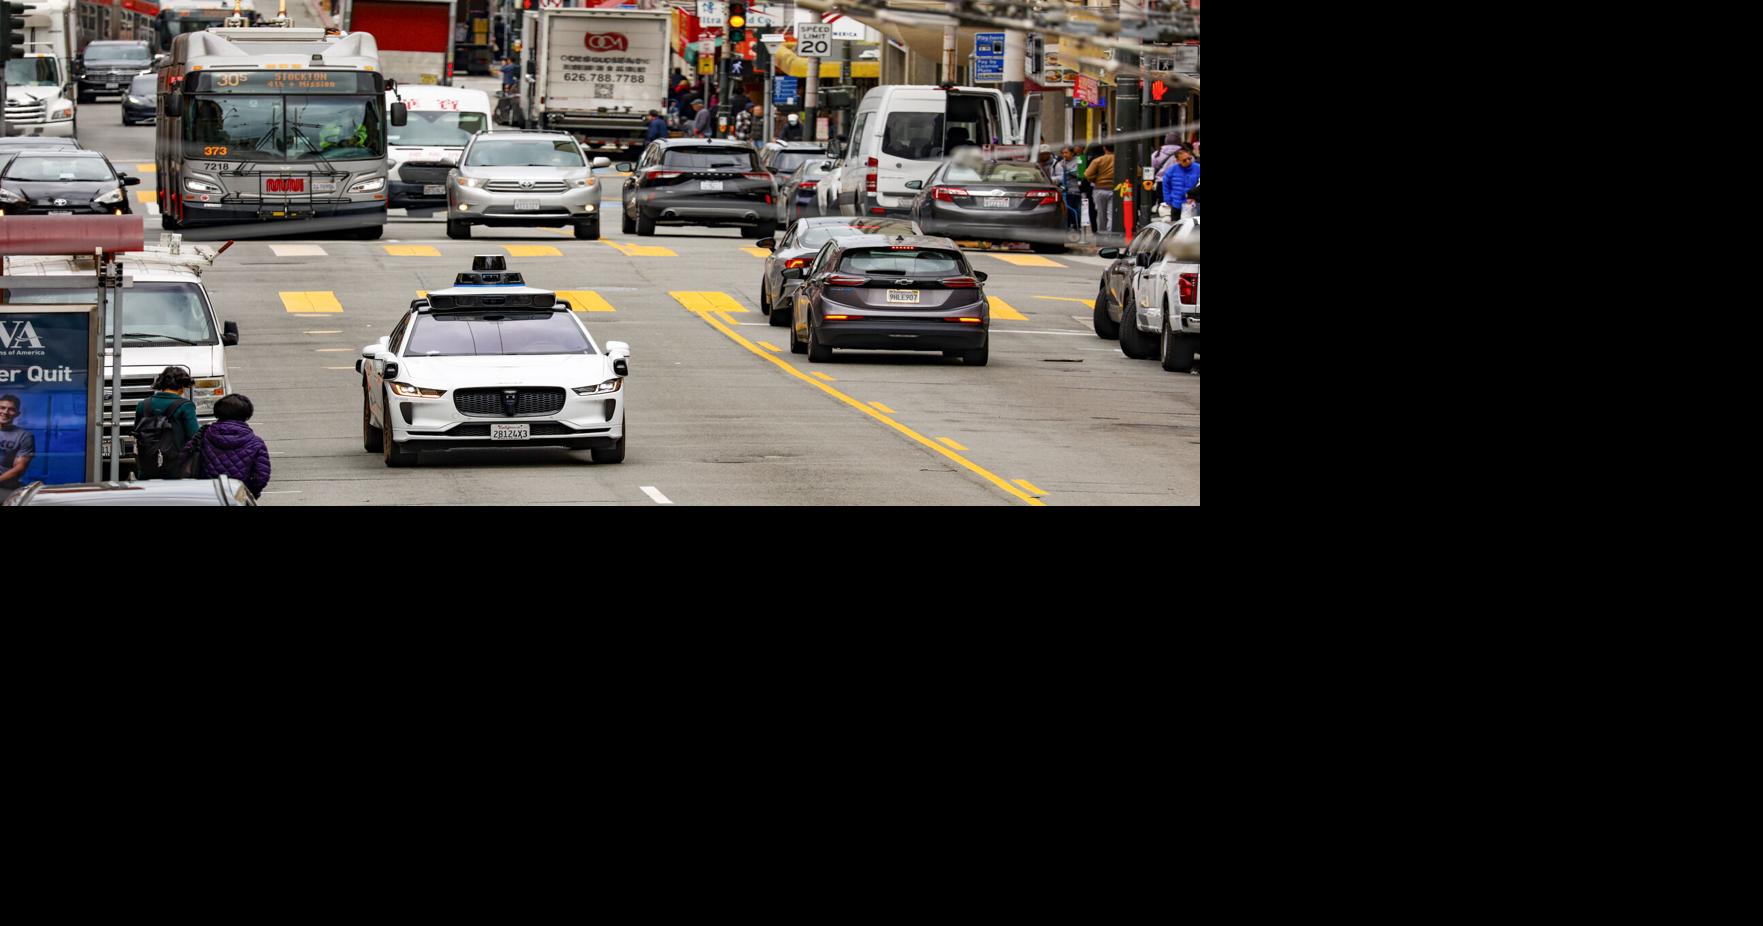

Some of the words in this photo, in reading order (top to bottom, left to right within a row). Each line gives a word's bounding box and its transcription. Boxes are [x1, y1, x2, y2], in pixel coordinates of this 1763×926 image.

[801, 41, 828, 53] 20
[275, 72, 327, 80] STOCKTON
[563, 73, 646, 83] 626.788.7788
[204, 146, 228, 156] 373
[204, 162, 229, 171] 7218
[266, 178, 304, 192] MUNI
[0, 369, 21, 382] er
[28, 365, 72, 382] Quit
